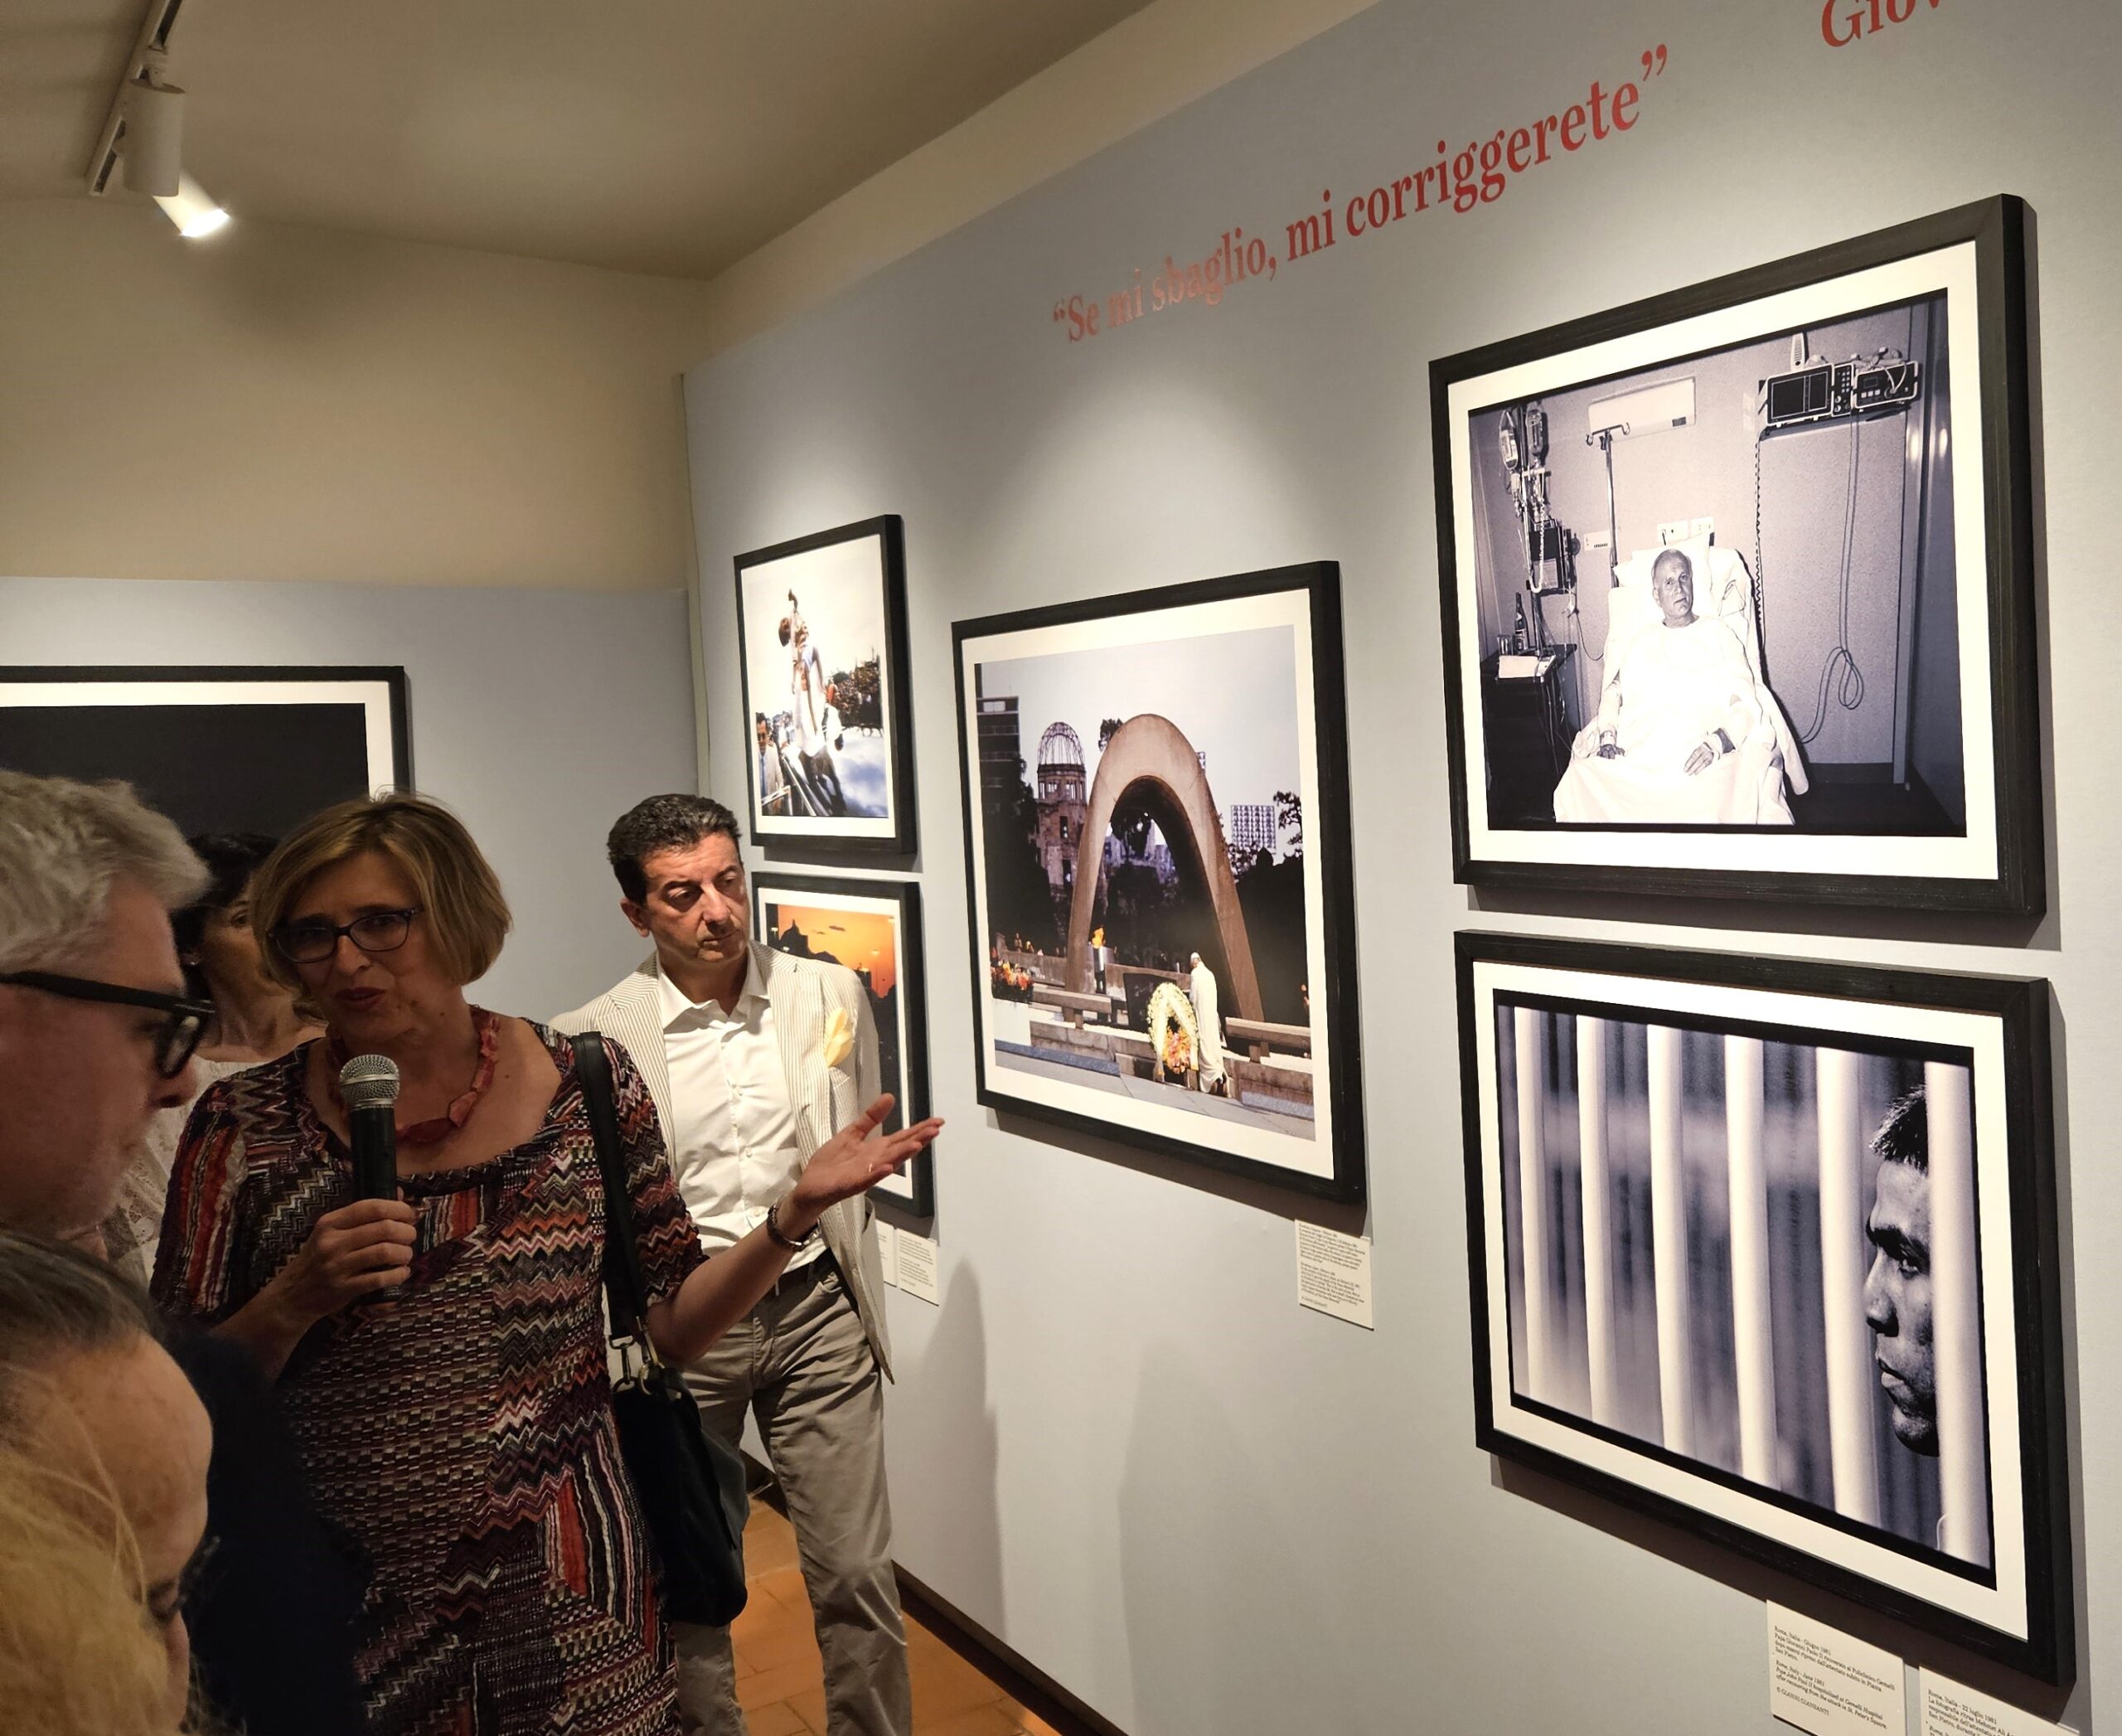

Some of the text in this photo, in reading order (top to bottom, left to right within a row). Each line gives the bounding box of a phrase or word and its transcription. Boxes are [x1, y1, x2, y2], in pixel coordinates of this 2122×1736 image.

[1107, 268, 1144, 328] mi
[1152, 226, 1277, 311] sbaglio,
[1286, 189, 1336, 262] mi
[1345, 42, 1669, 239] corriggerete”
